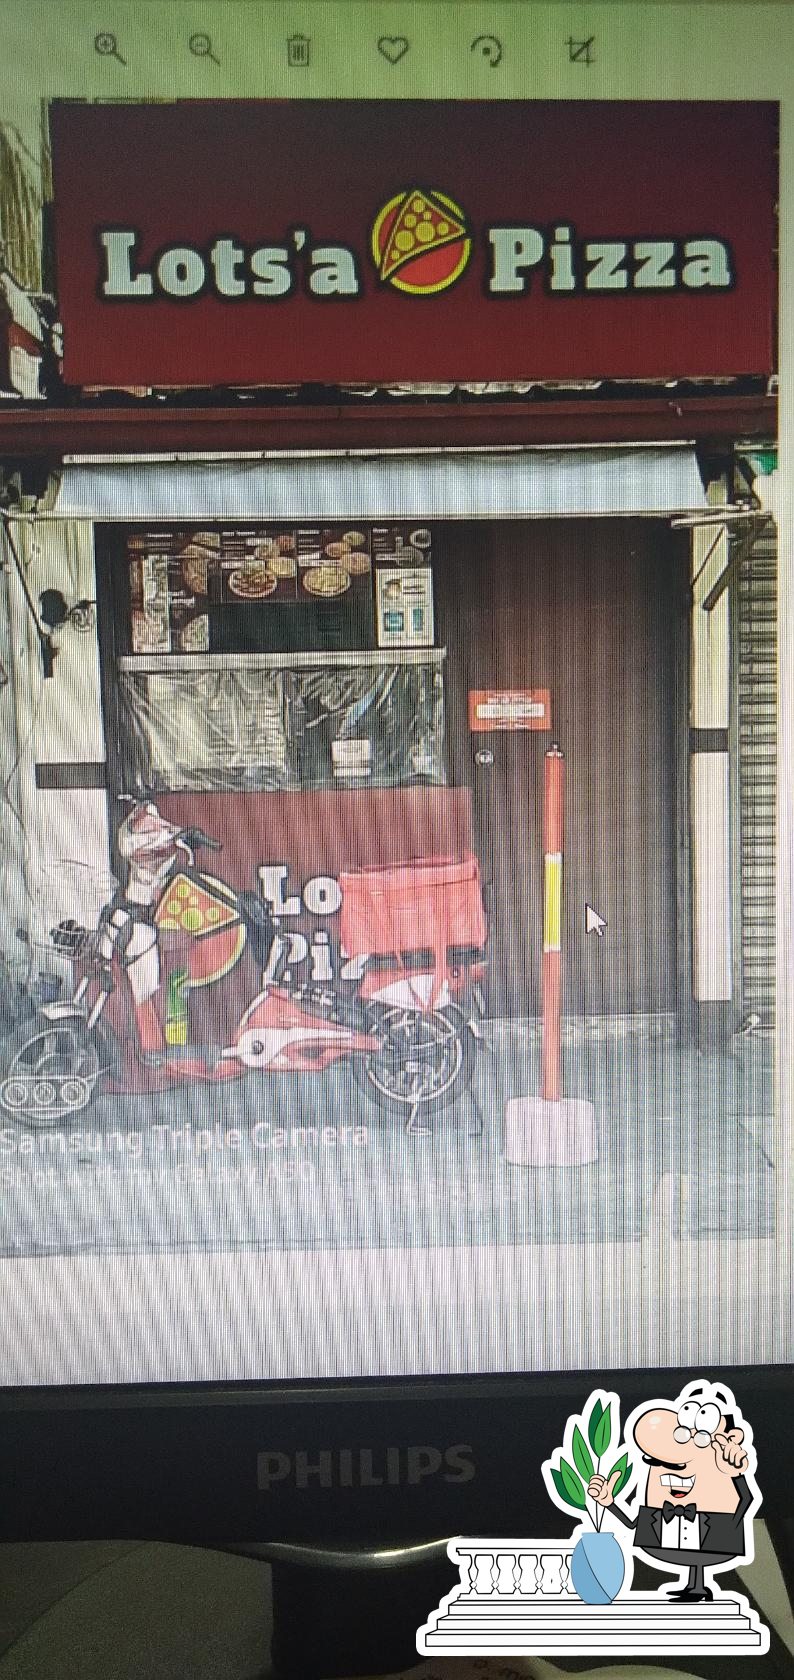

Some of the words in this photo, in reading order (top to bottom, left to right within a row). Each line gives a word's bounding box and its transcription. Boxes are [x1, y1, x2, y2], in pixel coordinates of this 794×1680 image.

[101, 230, 359, 297] Lots'a
[489, 226, 731, 292] Pizza
[257, 1444, 476, 1490] PHILIPS
